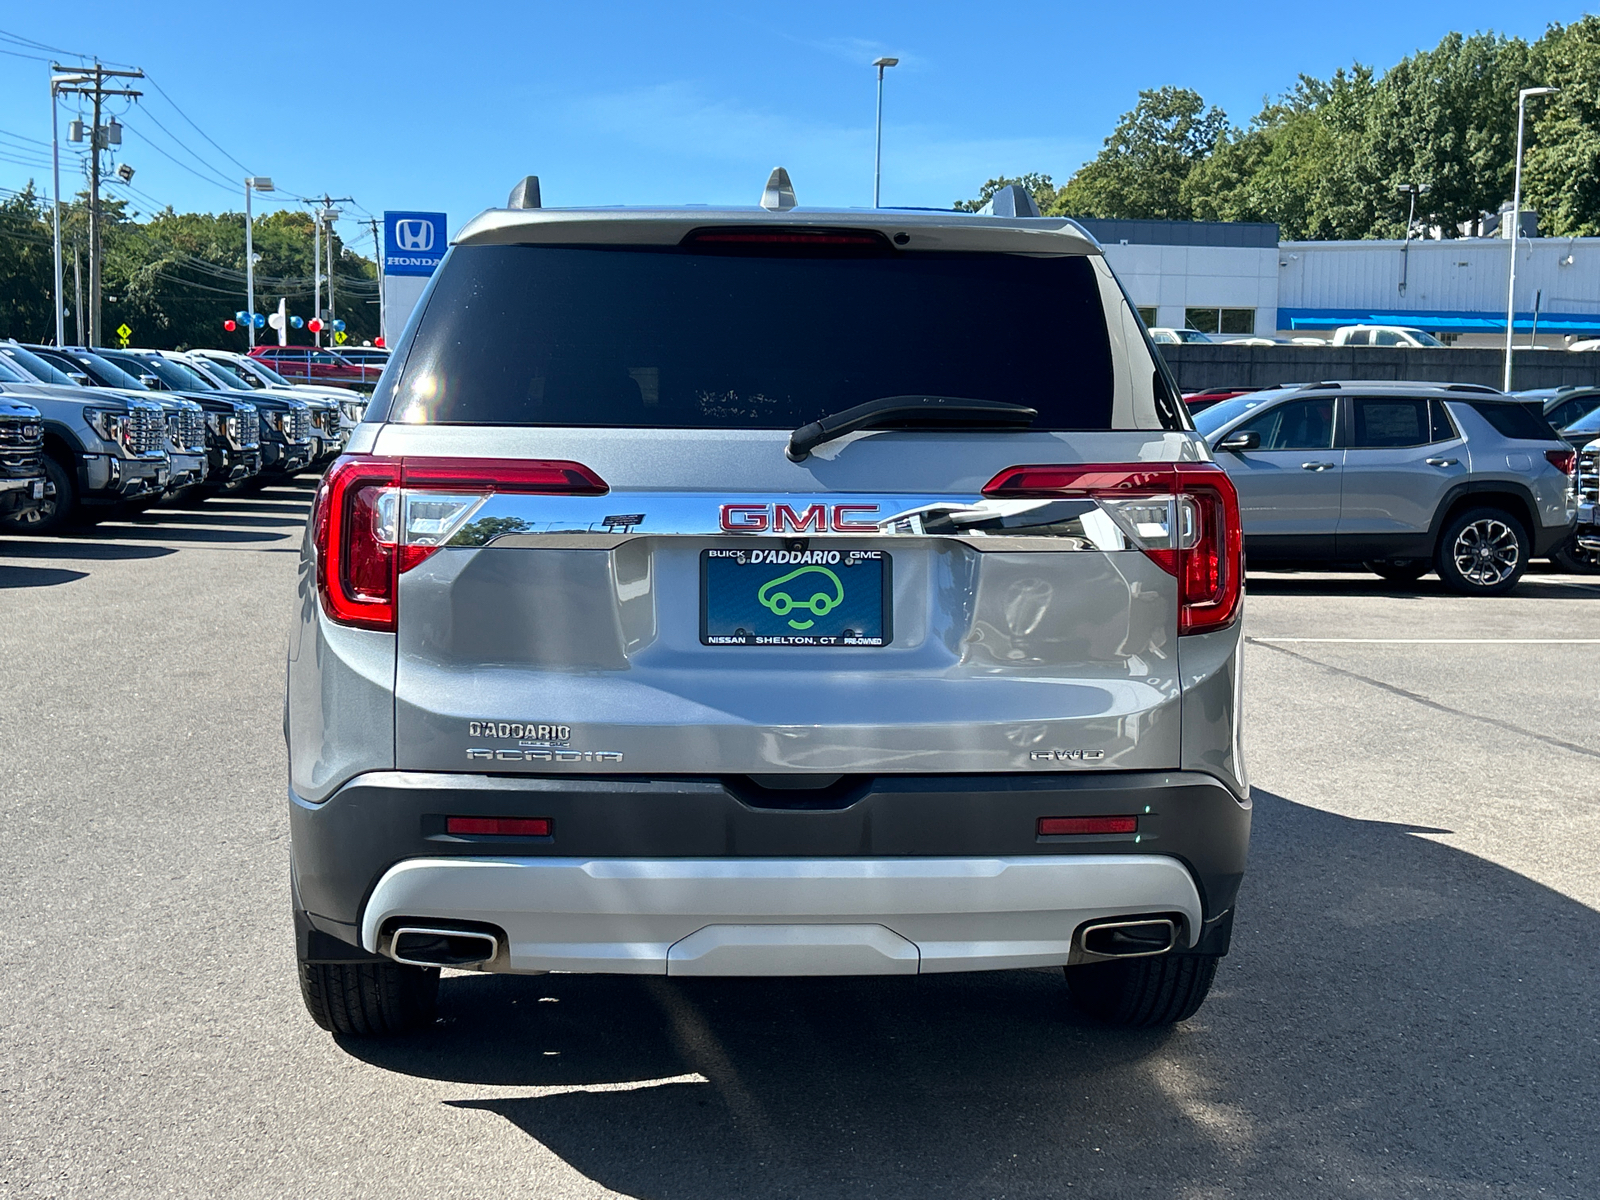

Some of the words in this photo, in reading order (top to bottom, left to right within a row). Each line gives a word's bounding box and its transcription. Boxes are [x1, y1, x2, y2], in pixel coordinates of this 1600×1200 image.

[387, 257, 440, 266] HONDA
[719, 503, 880, 532] GMC
[751, 550, 841, 564] D'ADDARIO
[850, 551, 881, 559] GMC
[708, 636, 746, 644] NISSAN
[755, 636, 817, 645] SHELTON,
[819, 636, 837, 644] CT
[844, 637, 882, 645] PRE-OWNED
[469, 721, 571, 740] D'ADDARIO
[466, 748, 623, 763] ACADIA
[1030, 750, 1104, 760] AWD
